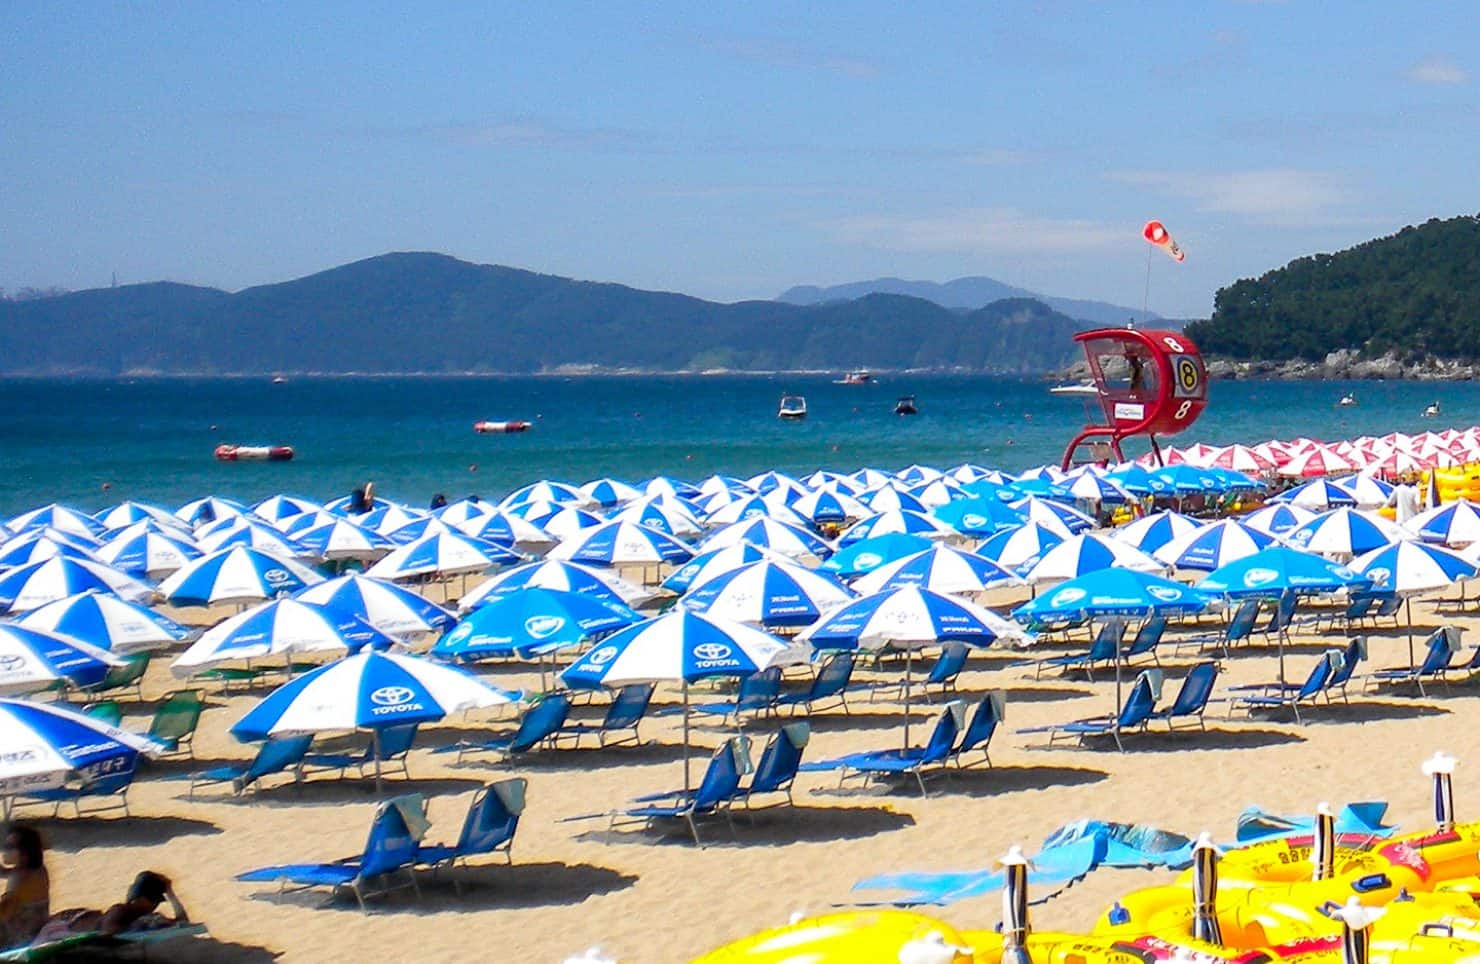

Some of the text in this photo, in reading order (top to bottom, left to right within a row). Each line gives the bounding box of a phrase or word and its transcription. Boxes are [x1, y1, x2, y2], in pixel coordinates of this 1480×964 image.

[1163, 337, 1184, 353] 8
[1182, 362, 1195, 388] 8
[1174, 400, 1192, 419] 8
[695, 659, 740, 669] TOYOTA
[371, 703, 425, 716] TOYOTA
